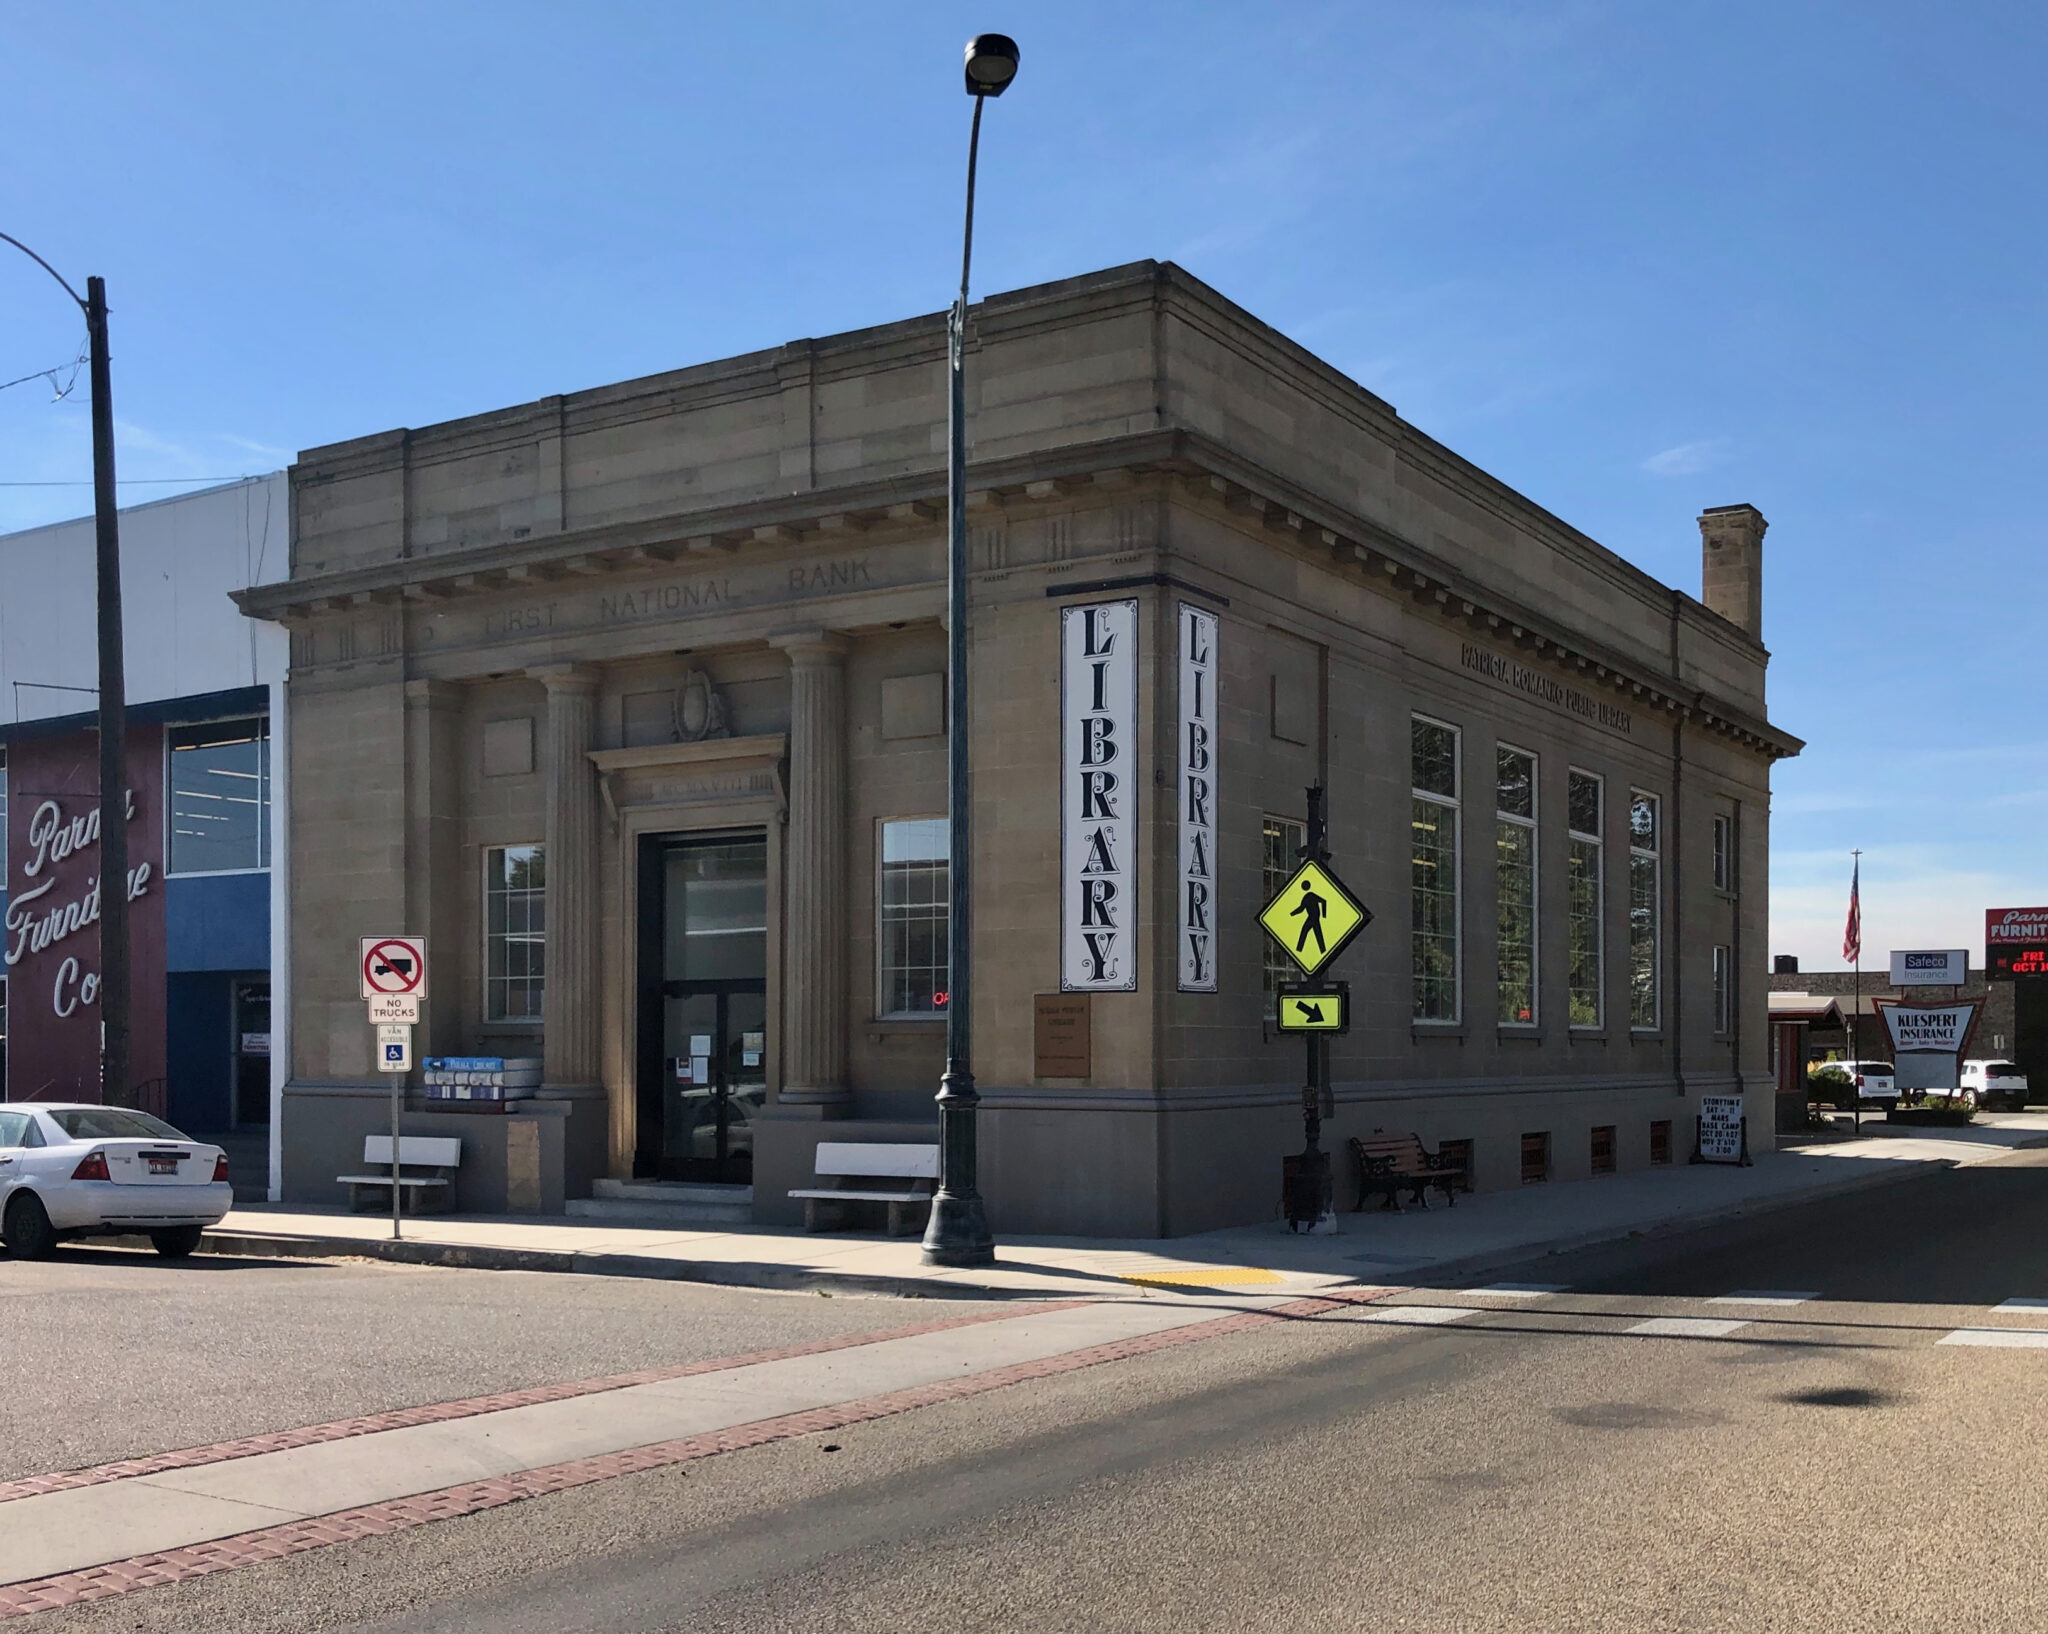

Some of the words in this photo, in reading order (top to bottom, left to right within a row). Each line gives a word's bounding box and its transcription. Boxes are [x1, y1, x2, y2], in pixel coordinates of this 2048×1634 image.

[600, 578, 739, 617] NATIONAL
[788, 558, 871, 592] BANK
[1461, 643, 1510, 684] PATRICIA
[1513, 665, 1563, 706] ROMANKO
[1566, 688, 1596, 718] PUBLIC
[1598, 703, 1632, 735] LIBRARY
[1079, 608, 1121, 983] LIBRARY
[1187, 613, 1211, 983] LIBRARY
[1908, 956, 1945, 967] Safeco
[2022, 951, 2045, 961] FRI
[2012, 962, 2037, 972] OCT
[1905, 970, 1948, 979] Insurance
[386, 999, 402, 1008] NO
[373, 1008, 415, 1017] TRUCKS
[1897, 1014, 1958, 1027] KUESPERT
[1900, 1028, 1956, 1039] INSURANCE
[1703, 1098, 1740, 1106] STORYTIME
